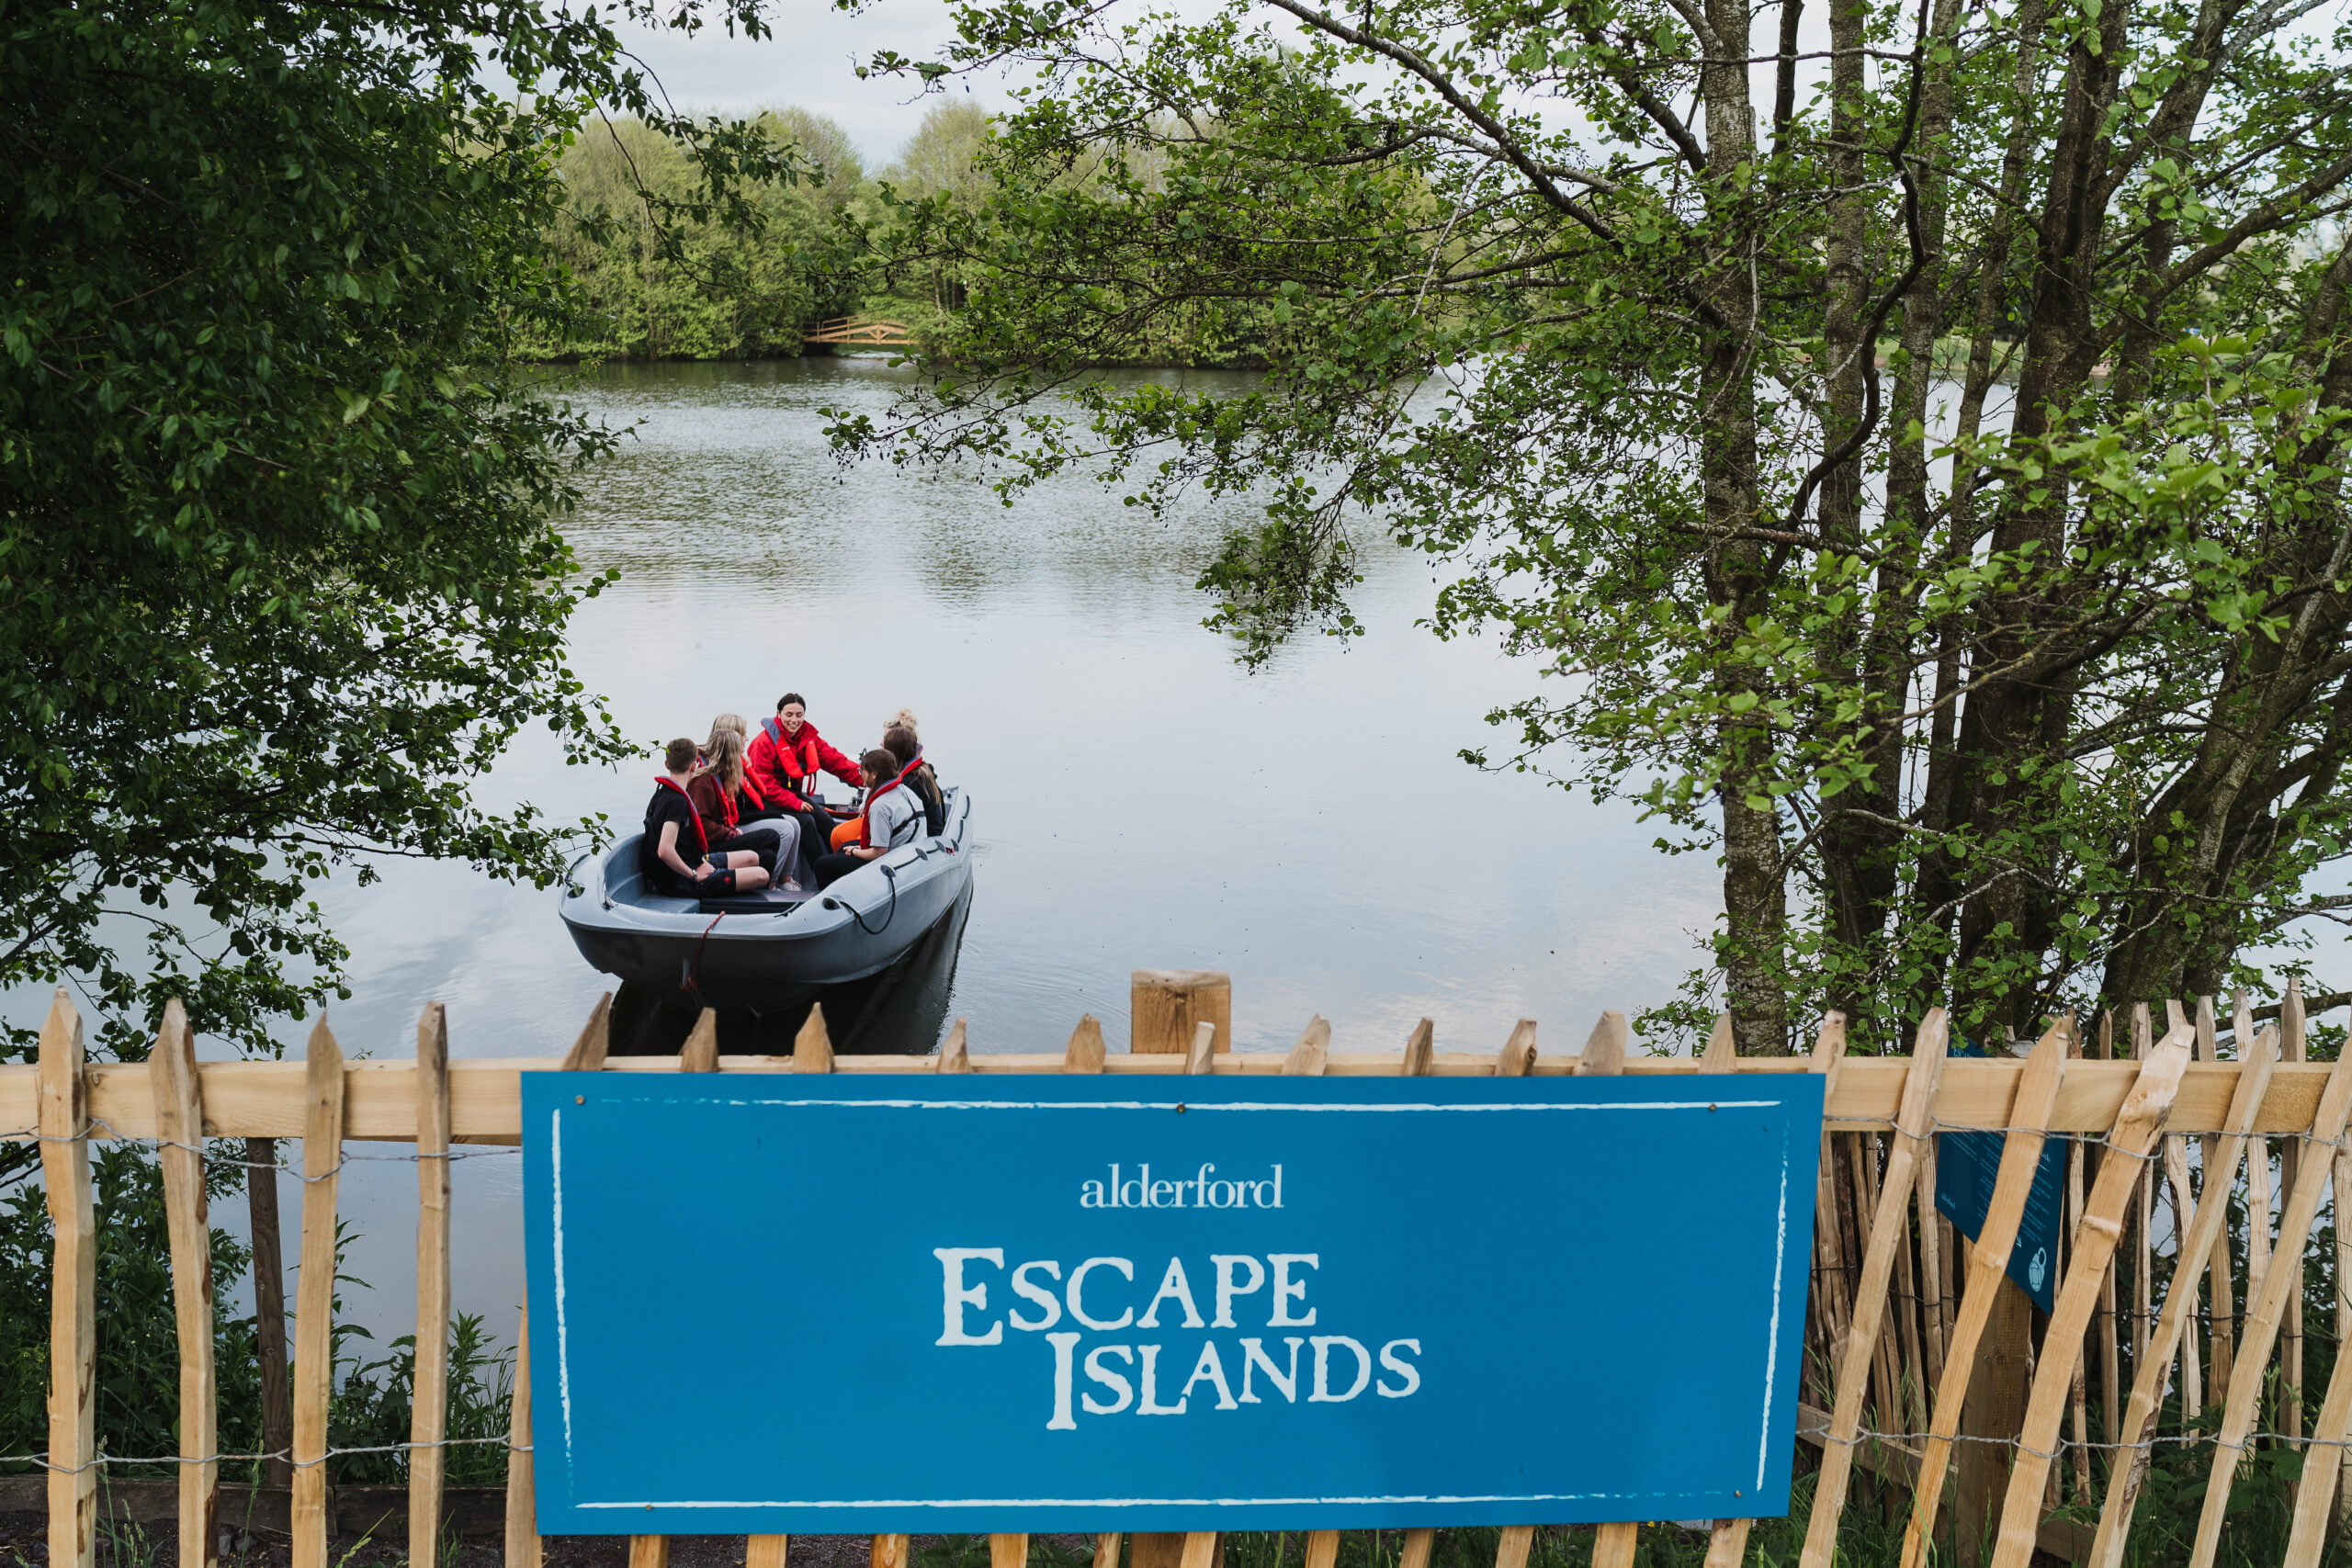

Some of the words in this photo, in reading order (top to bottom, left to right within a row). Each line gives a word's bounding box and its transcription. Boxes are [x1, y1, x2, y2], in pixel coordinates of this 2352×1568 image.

[1080, 1163, 1285, 1209] alderford
[933, 1247, 1319, 1347] ESCAPE
[1045, 1332, 1422, 1431] ISLANDS
